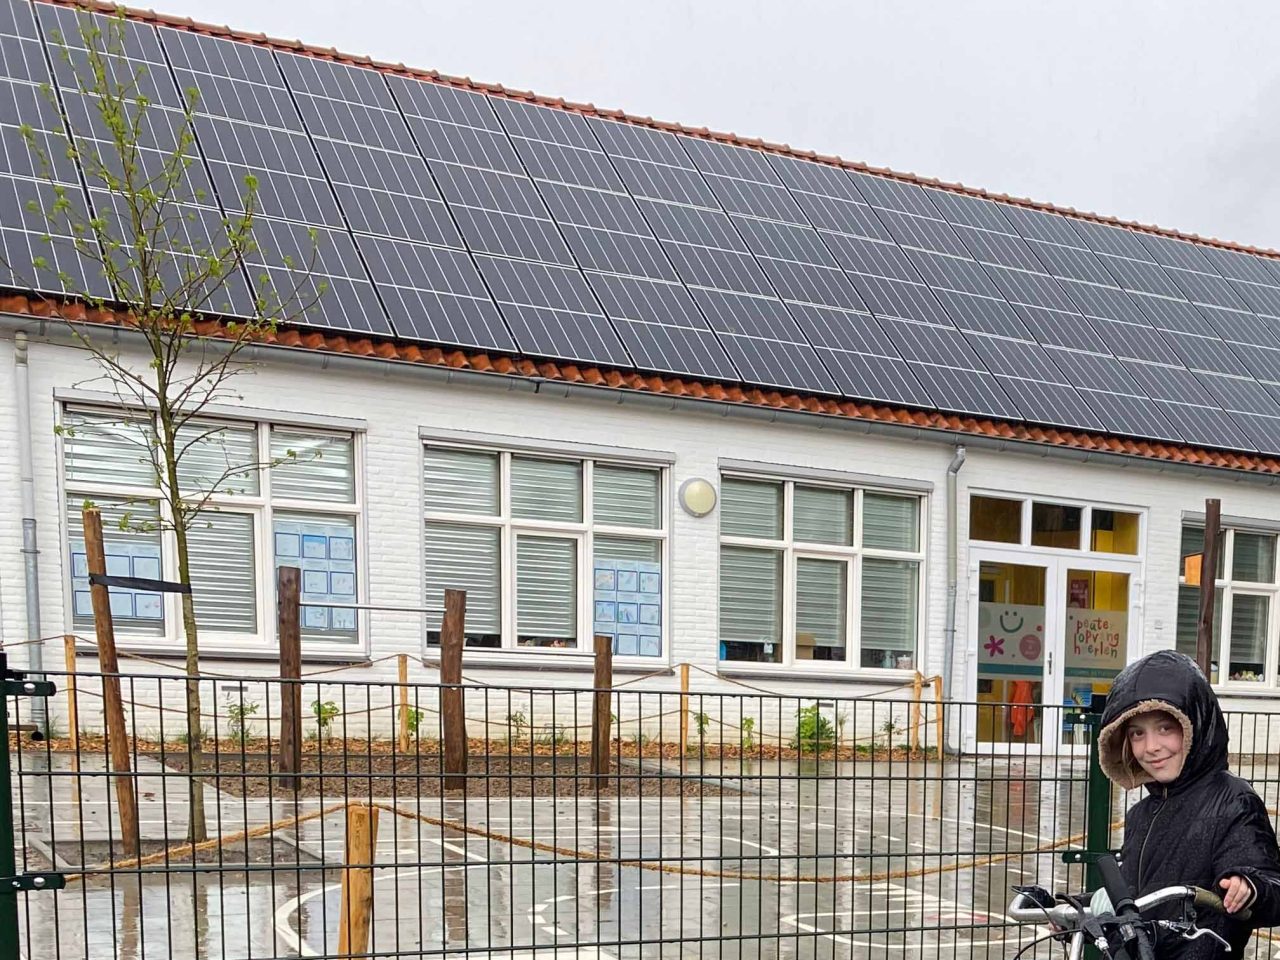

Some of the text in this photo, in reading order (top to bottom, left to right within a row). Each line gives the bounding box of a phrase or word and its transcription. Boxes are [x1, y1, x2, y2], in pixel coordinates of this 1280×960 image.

[1076, 617, 1112, 634] peute
[1074, 634, 1117, 658] herlen
[1078, 629, 1119, 647] opvng
